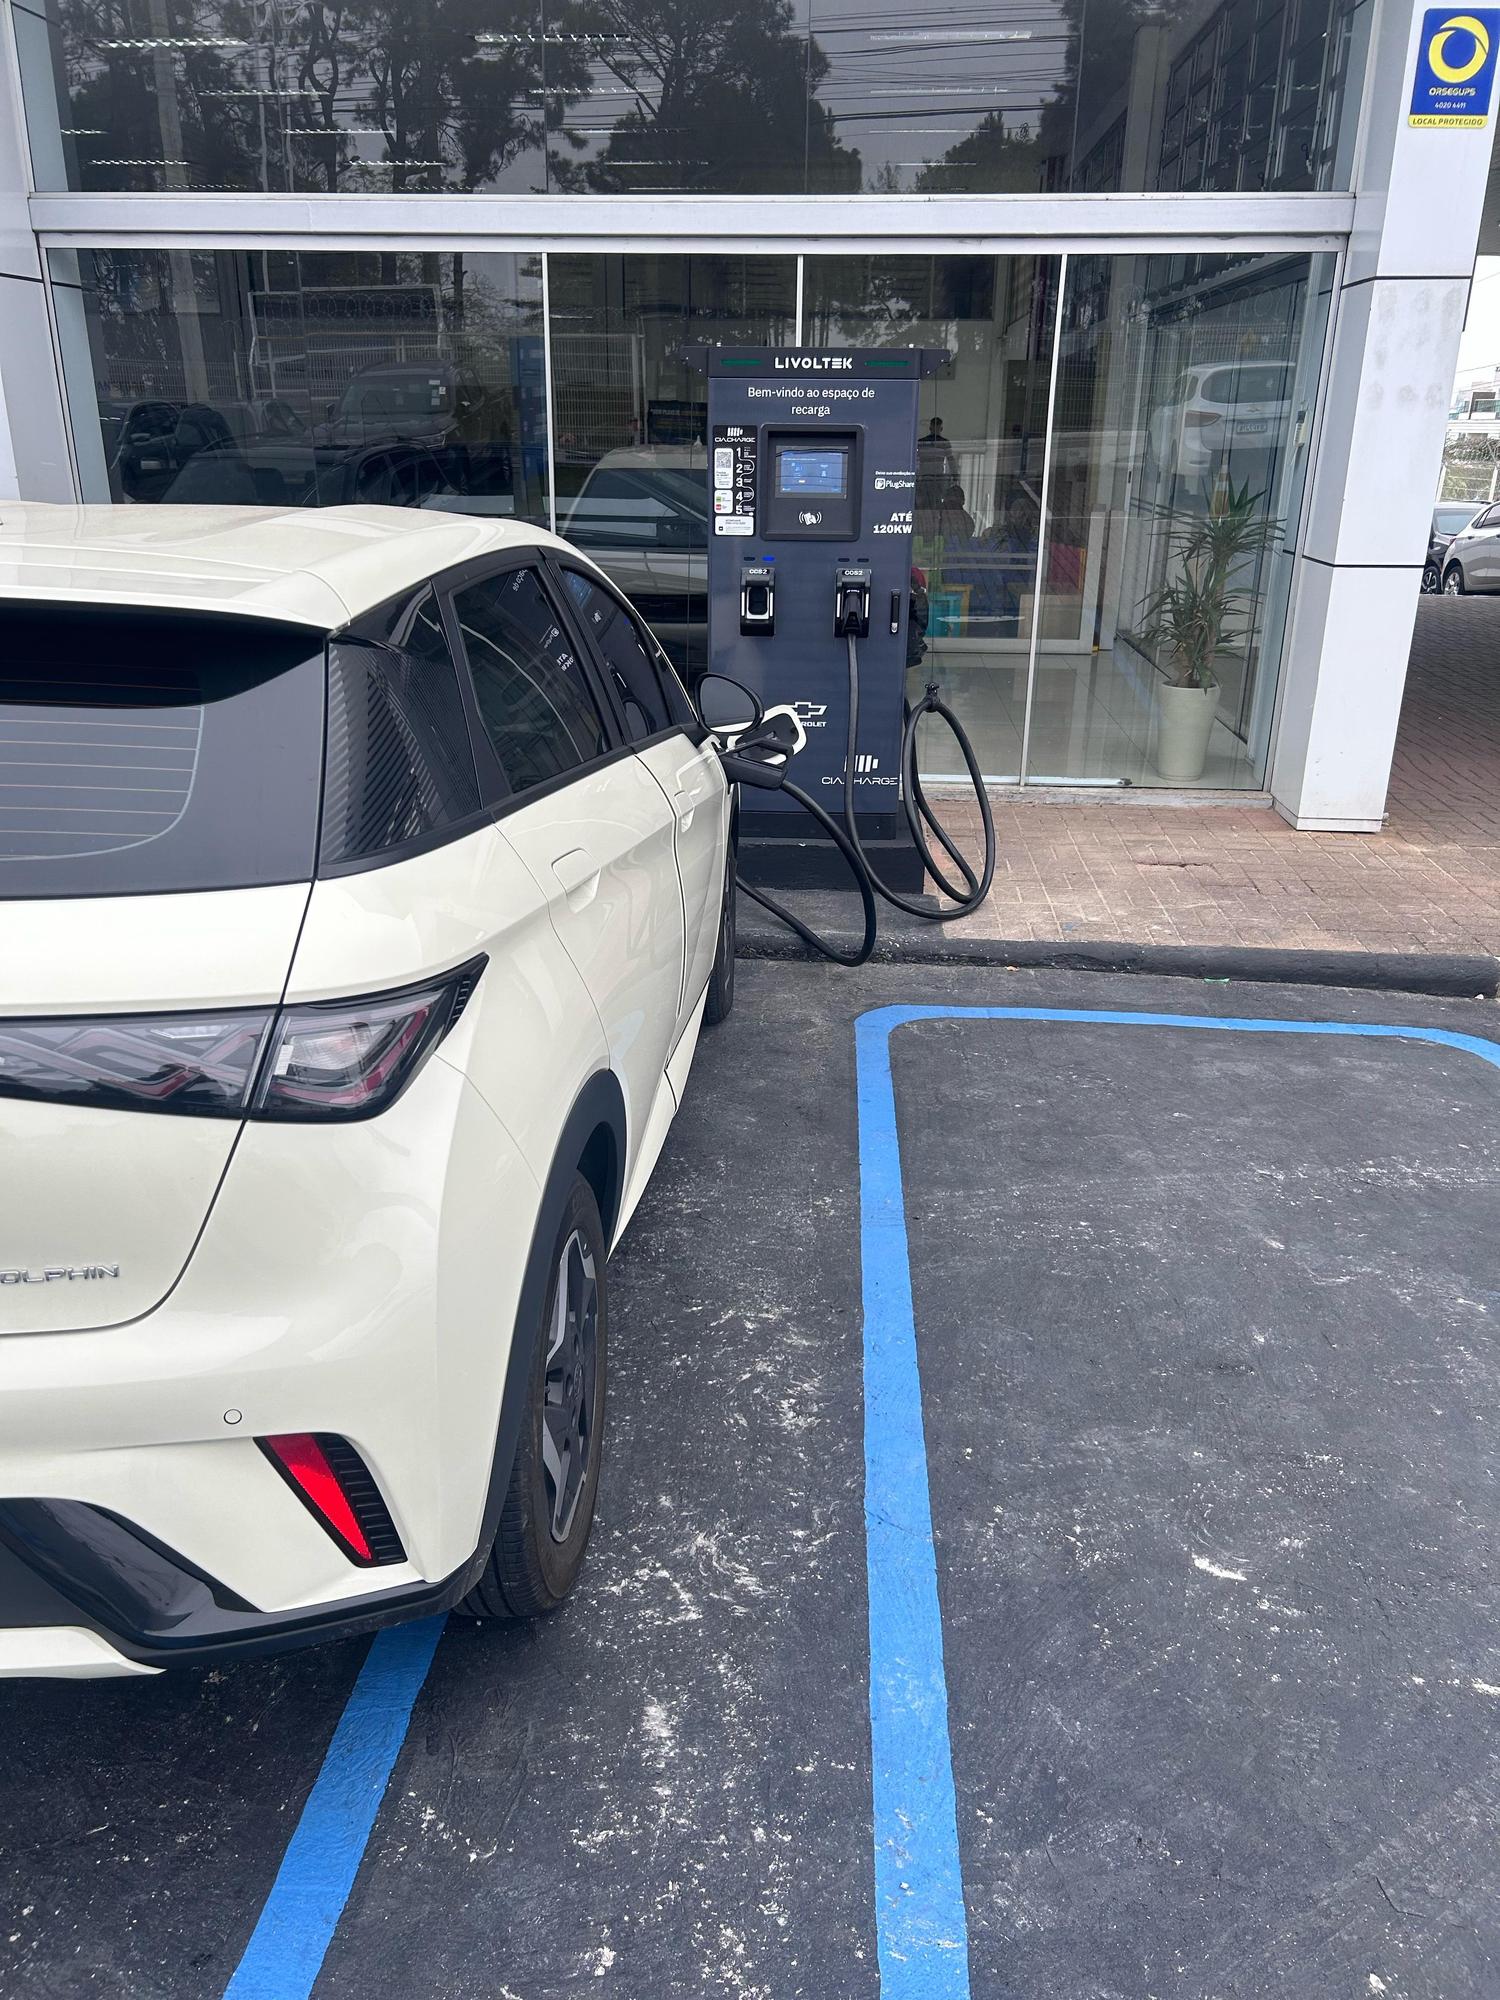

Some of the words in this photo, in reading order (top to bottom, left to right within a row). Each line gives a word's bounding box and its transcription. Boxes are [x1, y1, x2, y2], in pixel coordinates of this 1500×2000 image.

[1429, 87, 1476, 96] ORSEGUPS
[1413, 118, 1437, 126] LOCAL
[1438, 118, 1483, 126] PROTEGIDO
[774, 357, 853, 370] LIVOLTEK
[748, 387, 804, 398] Bem-vindo
[807, 389, 820, 398] ao
[822, 388, 859, 401] espaço
[861, 387, 875, 398] de
[791, 405, 830, 417] recarga
[736, 447, 741, 457] 1
[736, 464, 743, 473] 2
[736, 477, 743, 487] 3
[736, 491, 743, 501] 4
[736, 505, 743, 515] 5
[890, 511, 912, 522] ATÉ
[873, 524, 912, 534] 120KW
[821, 776, 898, 785] CIA.HARGE
[0, 1265, 119, 1283] OLPHIN
